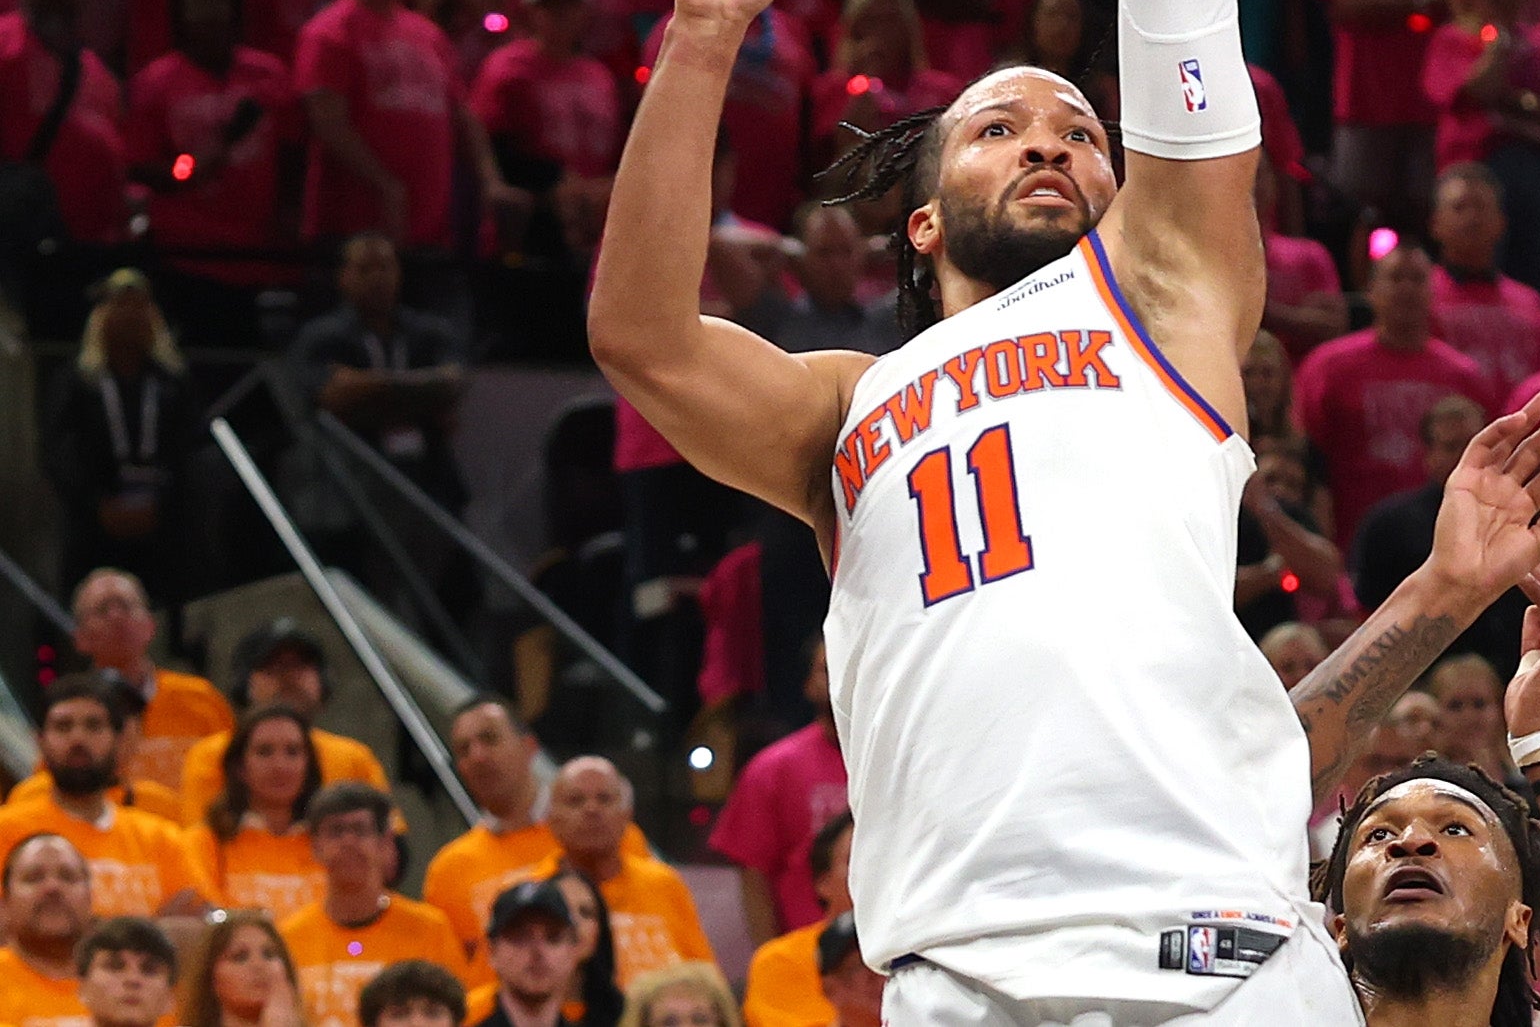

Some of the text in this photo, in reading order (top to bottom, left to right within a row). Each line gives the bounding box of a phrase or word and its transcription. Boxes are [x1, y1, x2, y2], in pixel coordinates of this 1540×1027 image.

[1028, 267, 1075, 295] dhabi
[834, 328, 1123, 519] NEW YORK
[907, 422, 1034, 608] 11
